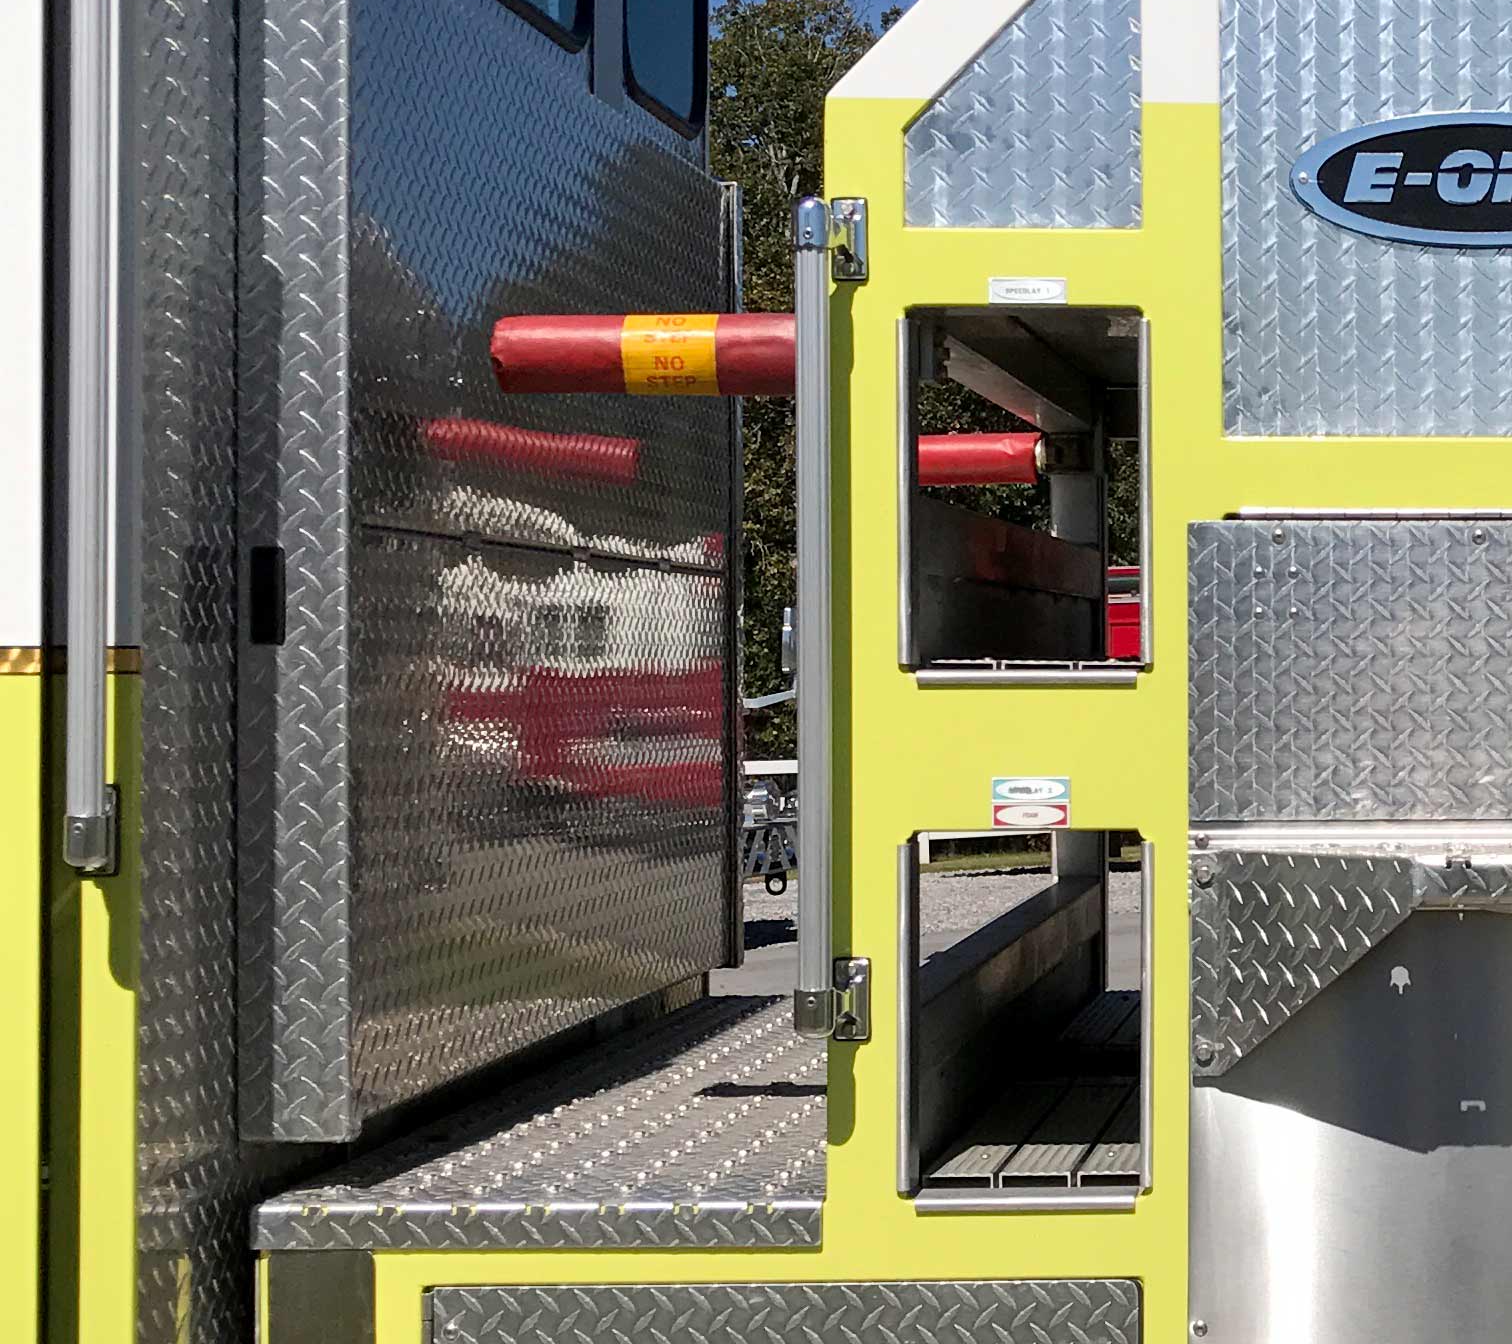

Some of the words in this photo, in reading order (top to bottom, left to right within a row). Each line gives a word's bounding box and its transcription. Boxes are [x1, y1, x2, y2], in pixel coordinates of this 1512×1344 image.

[656, 317, 687, 327] NO
[654, 356, 684, 371] NO
[646, 375, 697, 389] STEP
